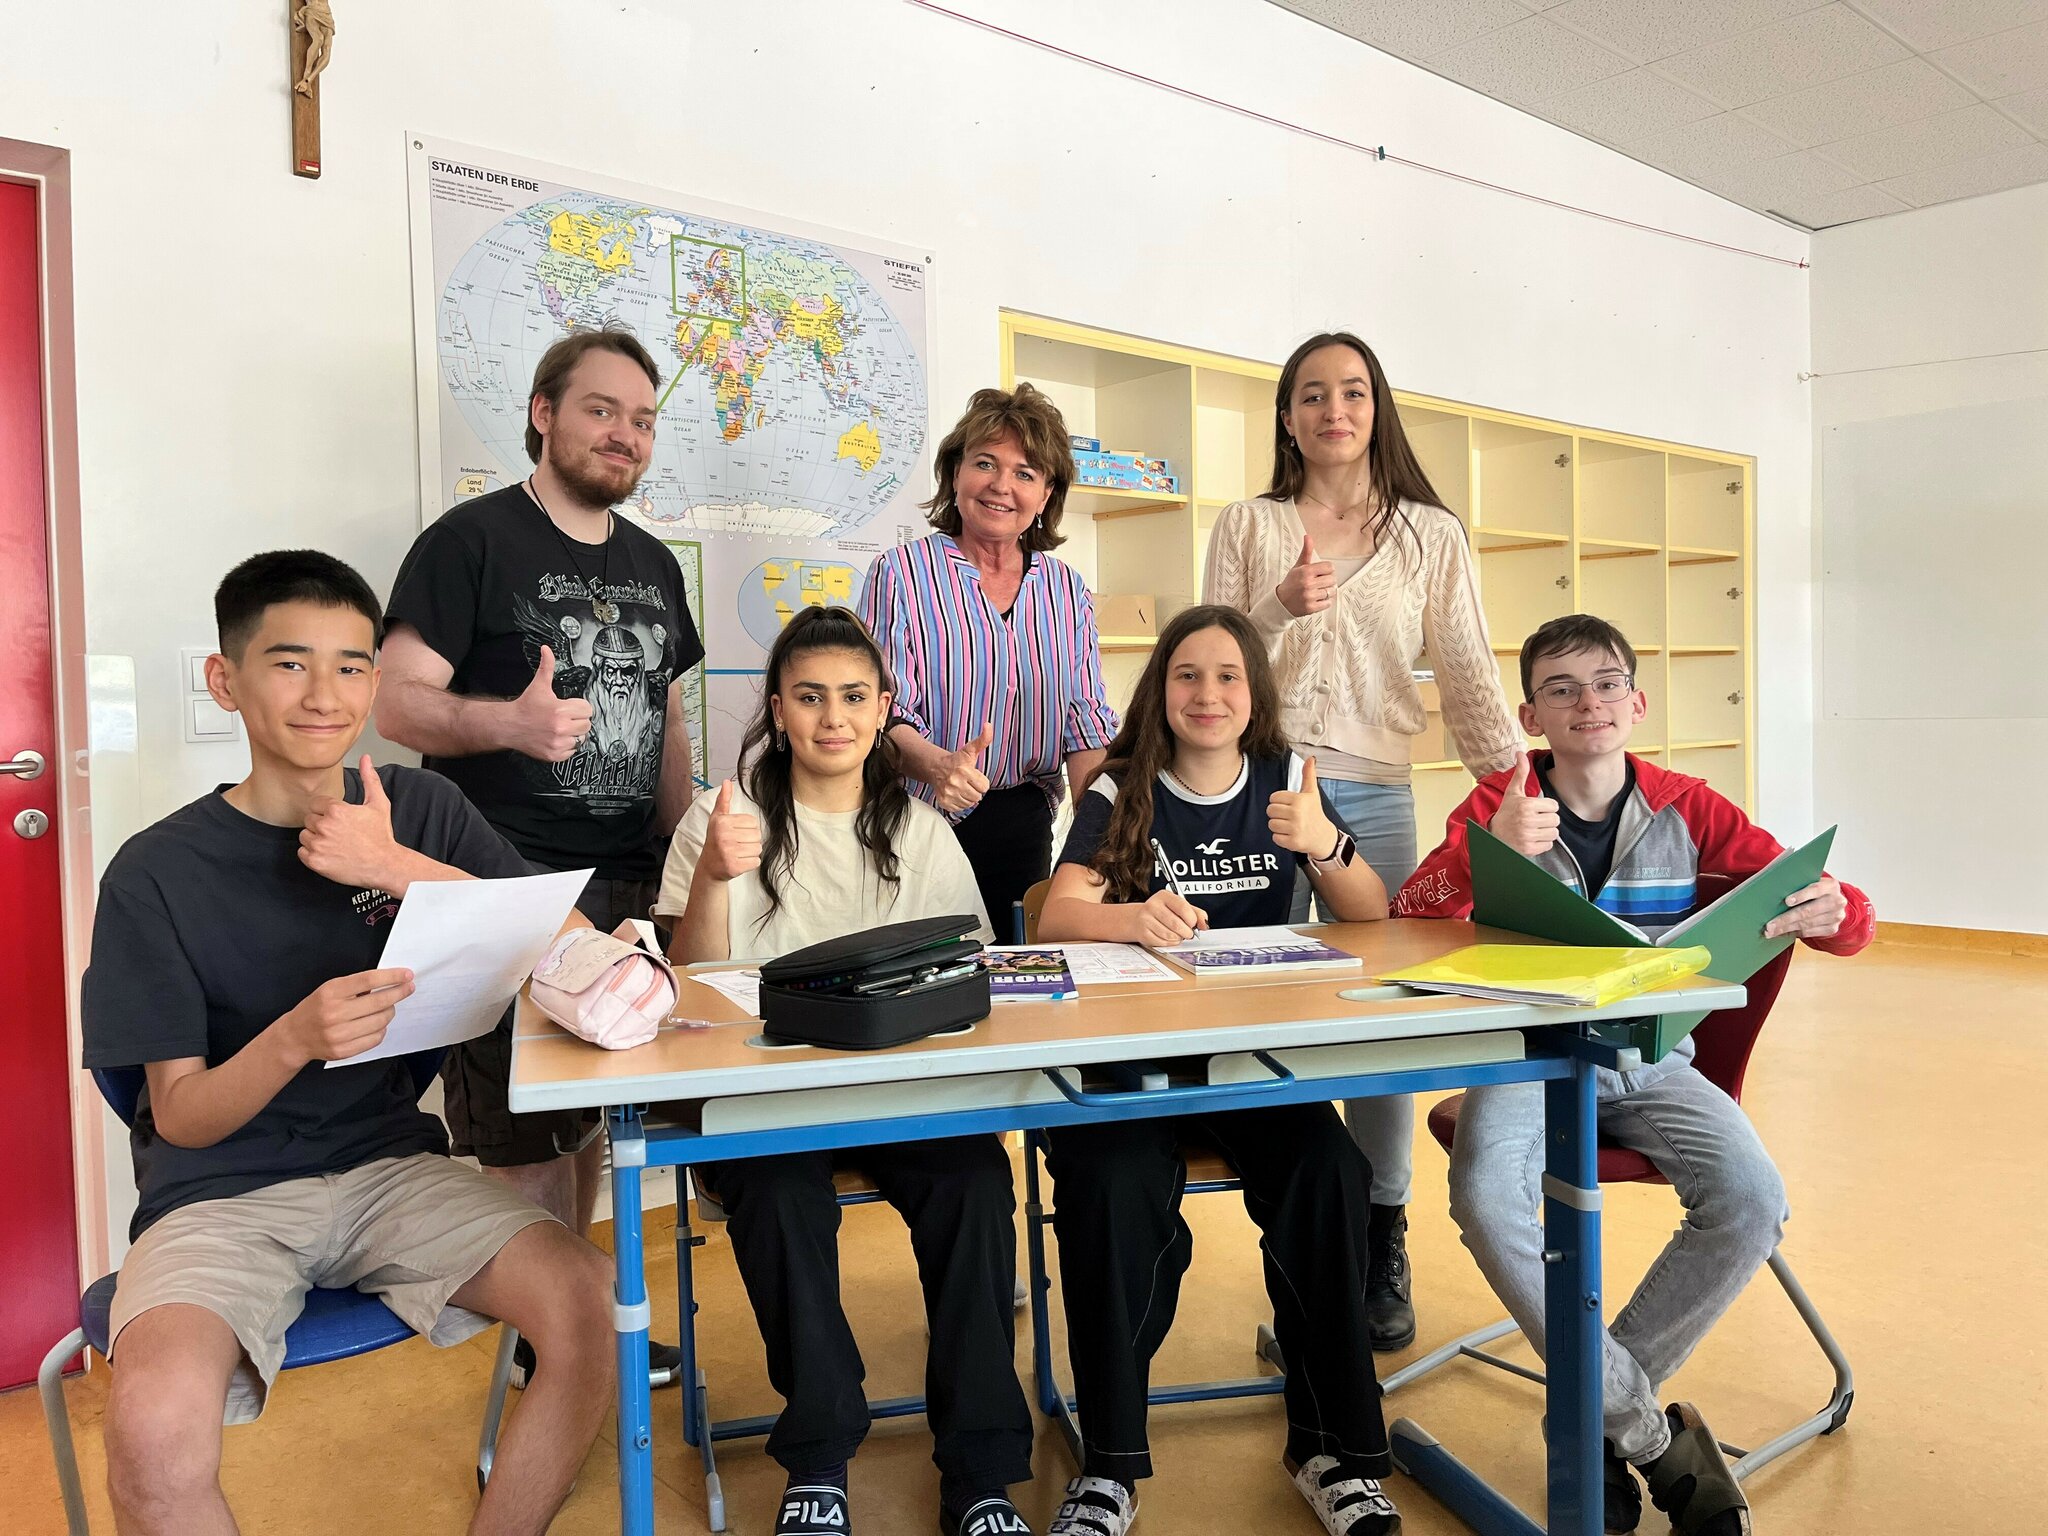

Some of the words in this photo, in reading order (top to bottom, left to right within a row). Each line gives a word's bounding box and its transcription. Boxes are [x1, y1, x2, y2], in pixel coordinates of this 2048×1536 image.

[431, 160, 483, 180] STAATEN
[486, 172, 508, 186] DER
[511, 178, 539, 193] ERDE
[485, 239, 525, 256] PAZIFISCHER
[488, 252, 510, 263] OZEAN
[883, 259, 923, 273] STIEFEL
[617, 287, 657, 299] ATLANTISCHER
[661, 416, 700, 424] ATLANTISCHER
[784, 412, 826, 423] INDISCHER
[466, 478, 482, 486] Land
[551, 750, 660, 791] VALHALLA
[1184, 878, 1262, 892] ALIFORNIA
[351, 890, 371, 906] KEEP
[989, 973, 1064, 984] MOR
[782, 1501, 844, 1526] FILA
[967, 1511, 1031, 1536] FILA
